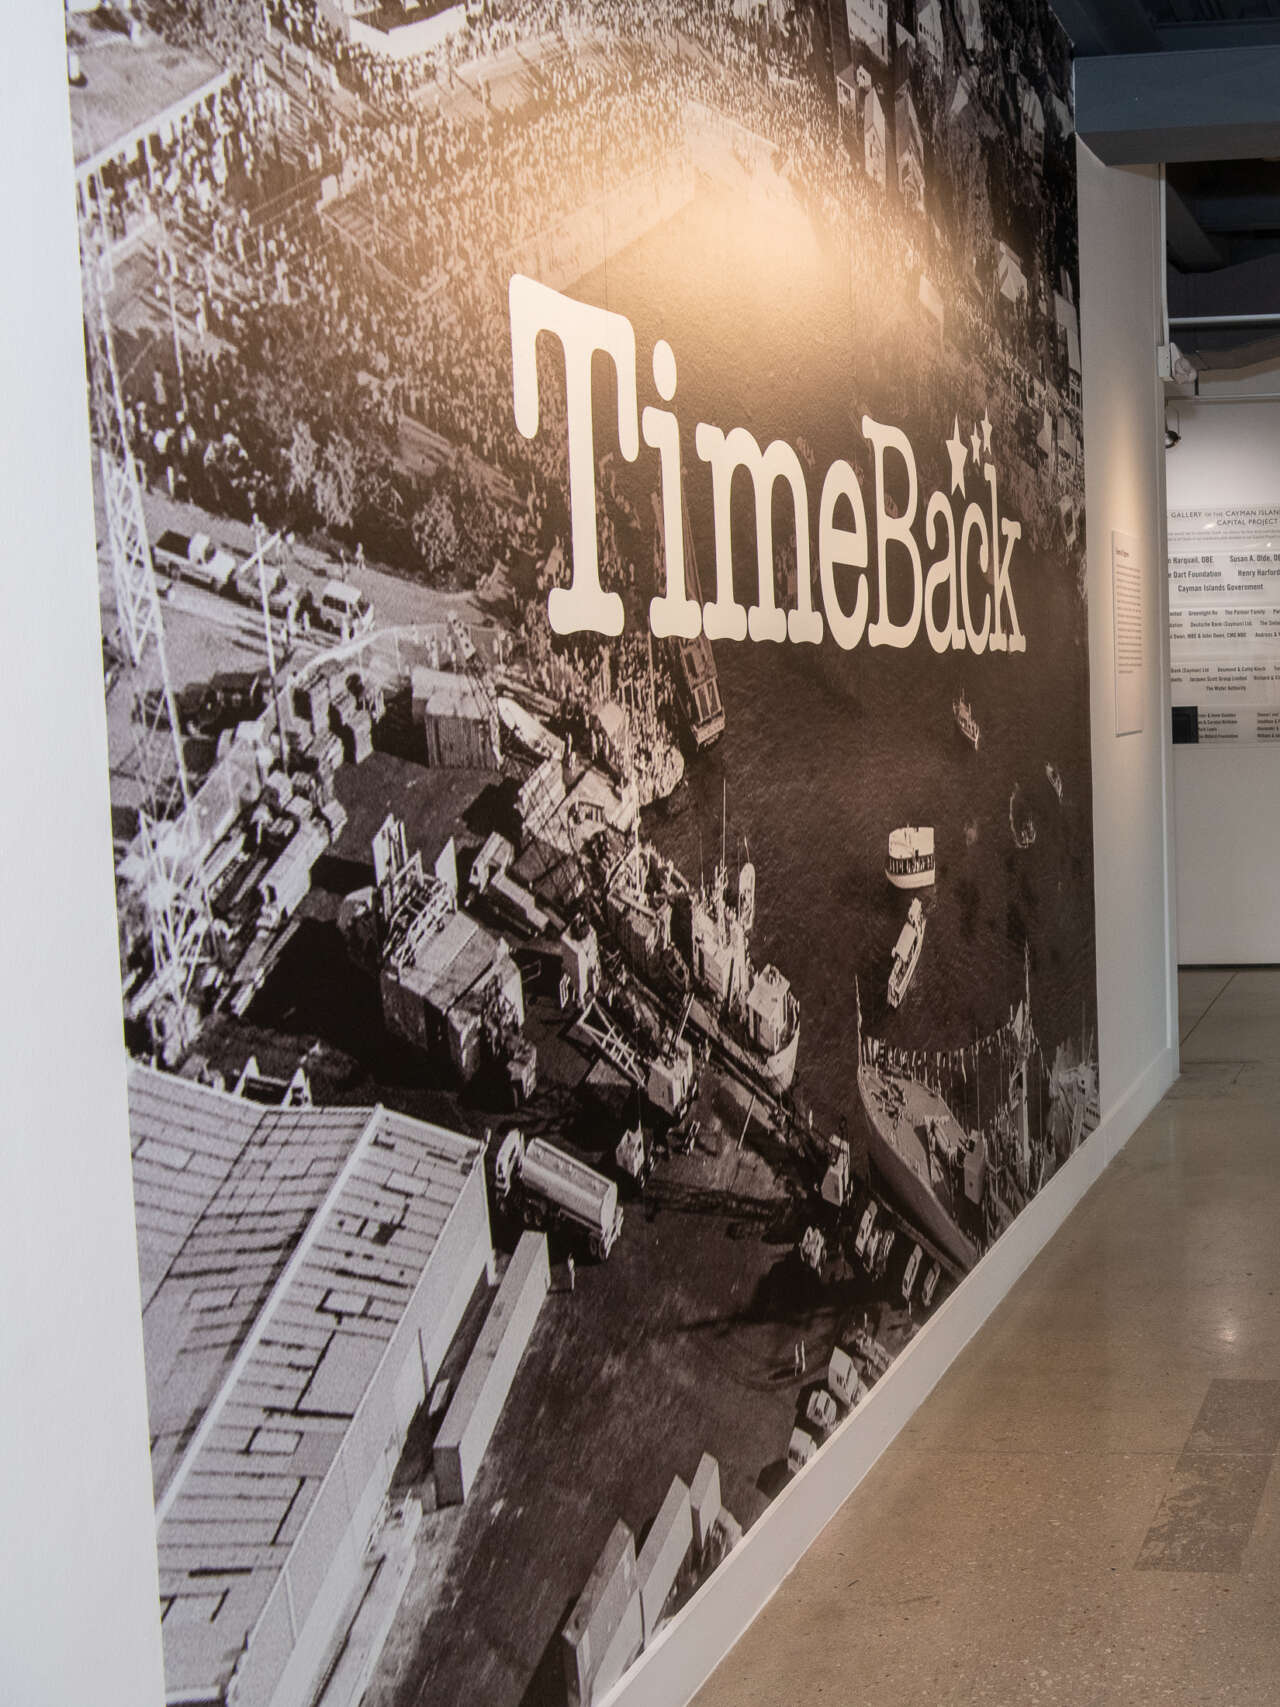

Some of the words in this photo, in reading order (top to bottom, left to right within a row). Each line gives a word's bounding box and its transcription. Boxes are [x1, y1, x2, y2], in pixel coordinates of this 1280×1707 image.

[508, 273, 1027, 655] TimeBack
[1170, 511, 1202, 519] GALLERY
[1225, 509, 1257, 518] CAYMAN
[1216, 518, 1246, 527] CAPITAL
[1248, 517, 1278, 526] PROJECT
[1229, 554, 1248, 563] Susan
[1173, 571, 1187, 579] Dart
[1188, 570, 1222, 578] Foundation
[1237, 569, 1255, 578] Henry
[1256, 568, 1280, 577] Harford
[1177, 585, 1202, 593] Cayman
[1203, 584, 1226, 592] Islands
[1226, 583, 1264, 591] Government
